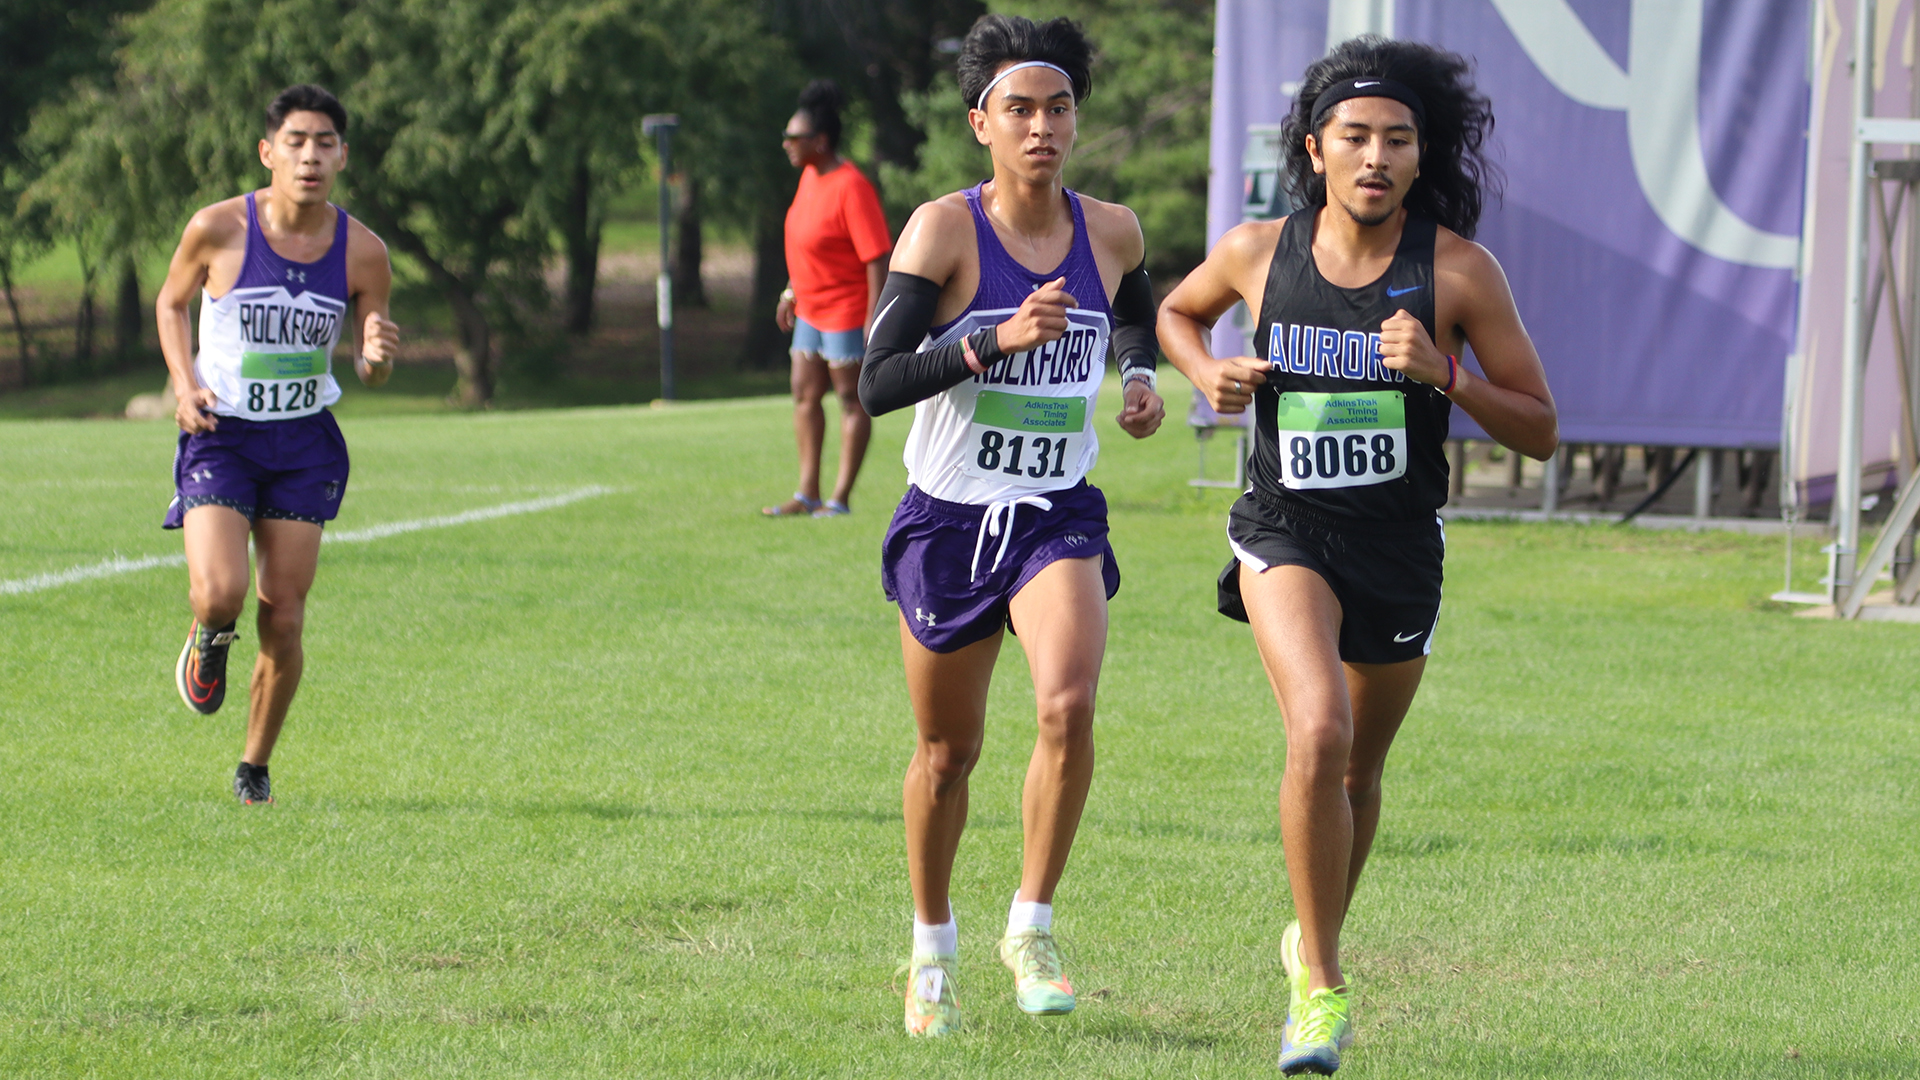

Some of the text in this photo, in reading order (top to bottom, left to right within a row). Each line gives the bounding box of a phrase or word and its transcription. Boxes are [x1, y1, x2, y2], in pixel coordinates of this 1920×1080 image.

[241, 304, 336, 345] ROCKFORD
[1268, 322, 1421, 384] AUROR
[248, 379, 318, 412] 8128
[1022, 418, 1067, 427] Associates
[1043, 410, 1068, 419] Timing
[1326, 416, 1379, 425] Associates
[1346, 408, 1378, 417] Timing
[977, 430, 1068, 478] 8131
[1290, 433, 1395, 480] 8068
